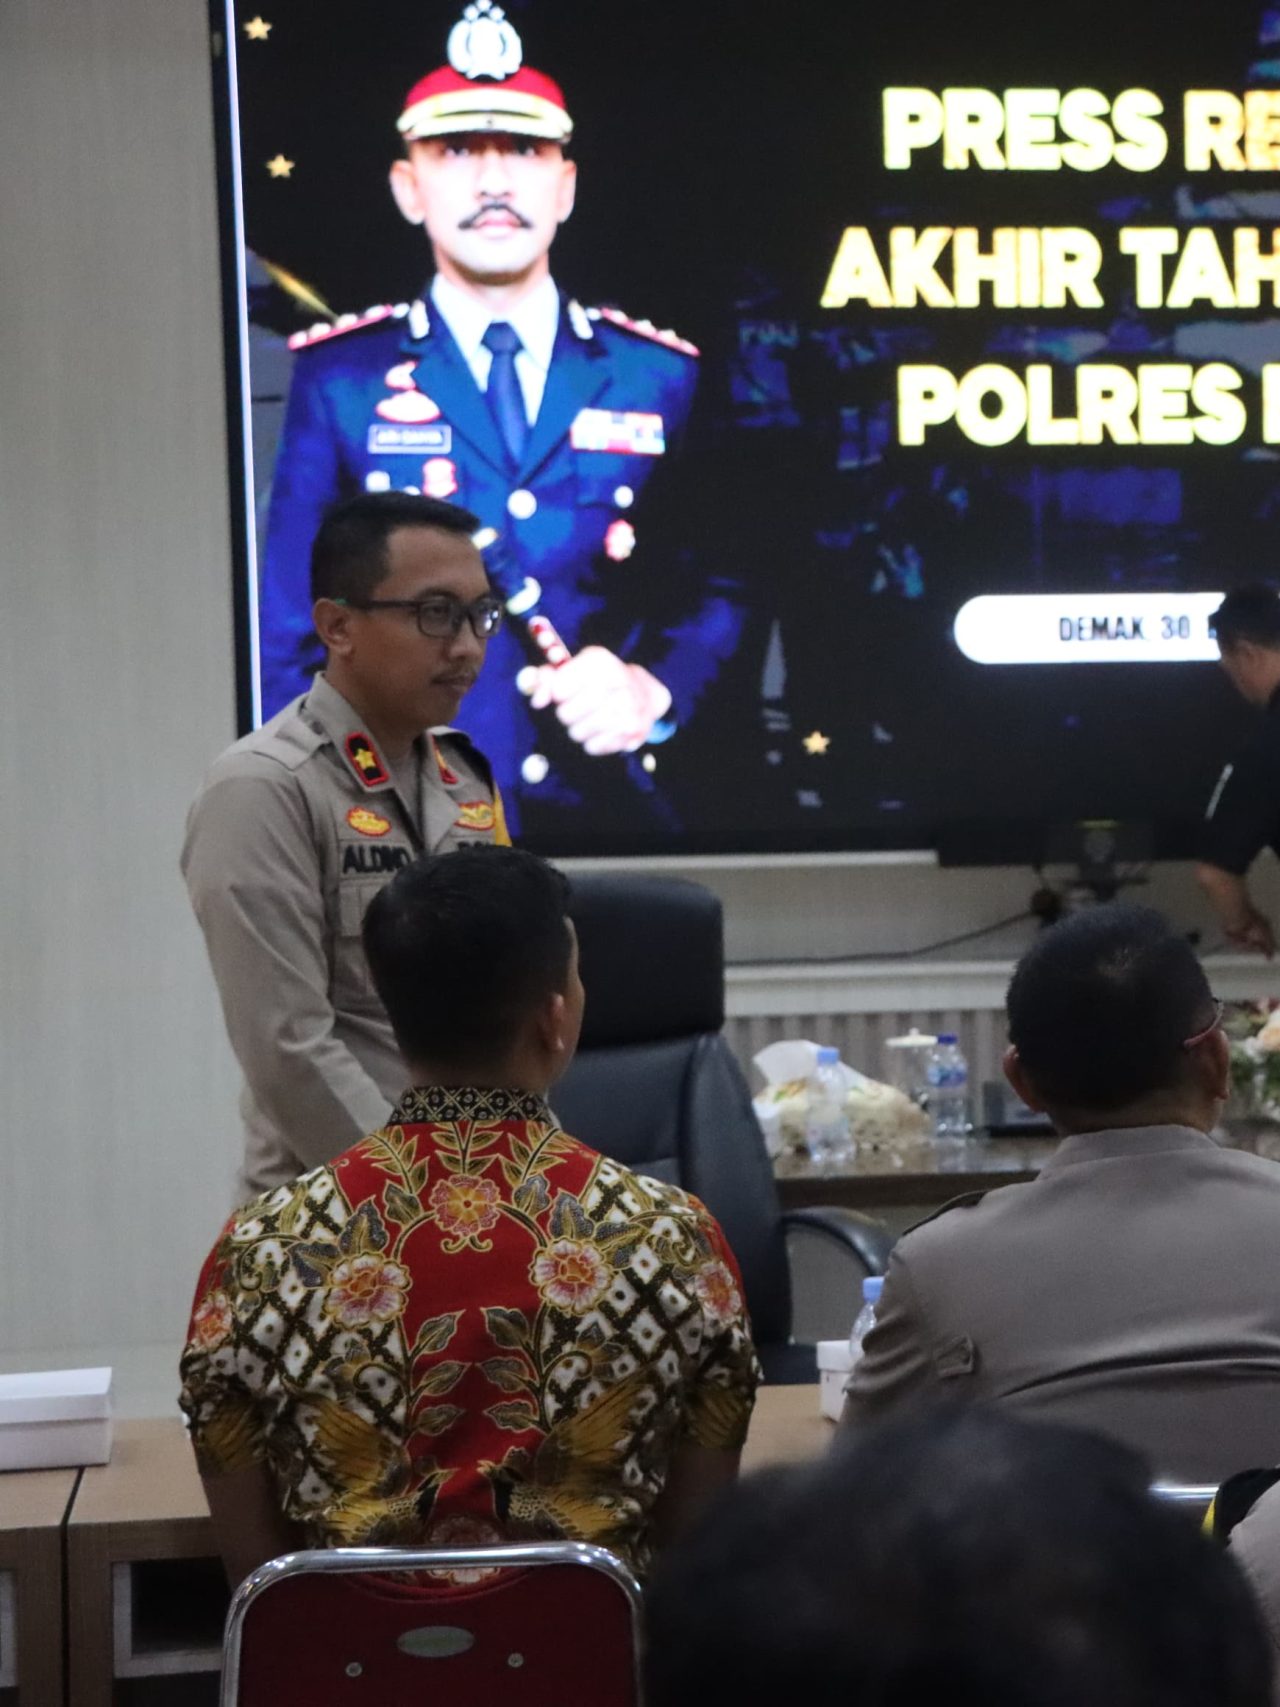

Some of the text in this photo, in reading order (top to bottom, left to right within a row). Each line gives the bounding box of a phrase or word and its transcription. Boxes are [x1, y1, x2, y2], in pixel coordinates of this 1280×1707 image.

[882, 88, 1168, 172] PRESS
[820, 226, 1105, 308] AKHIR
[897, 363, 1247, 446] POLRES
[1161, 615, 1190, 639] 30
